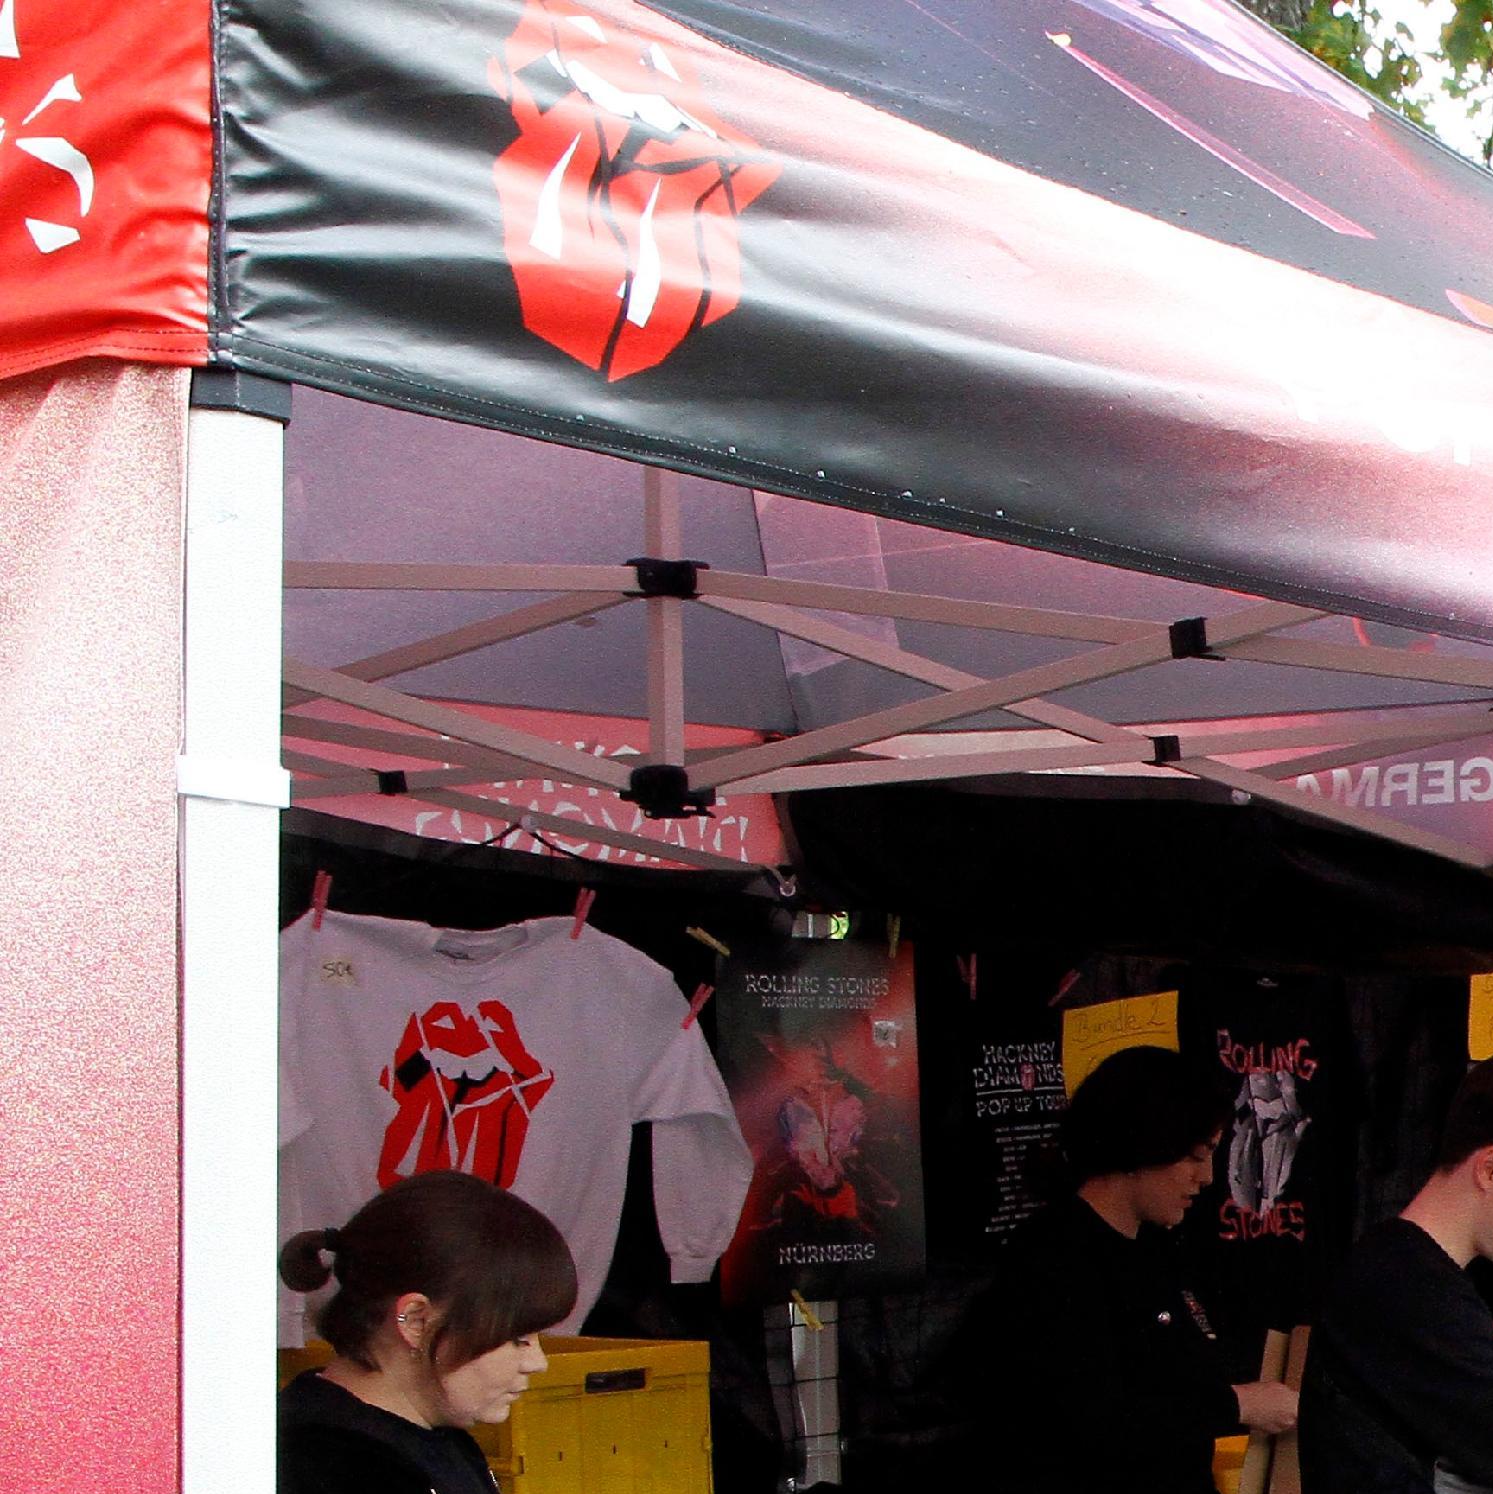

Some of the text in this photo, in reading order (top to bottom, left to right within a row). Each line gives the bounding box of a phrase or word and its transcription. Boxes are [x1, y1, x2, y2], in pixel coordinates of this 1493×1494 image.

[745, 973, 890, 996] ROLLING STONES
[982, 1041, 1056, 1066] HACKNEY
[1215, 1027, 1320, 1081] ROLLING
[976, 1098, 1011, 1118] POP
[1014, 1097, 1033, 1112] UP
[1216, 1199, 1307, 1245] STONES
[778, 1241, 877, 1265] NÜRNBERG
